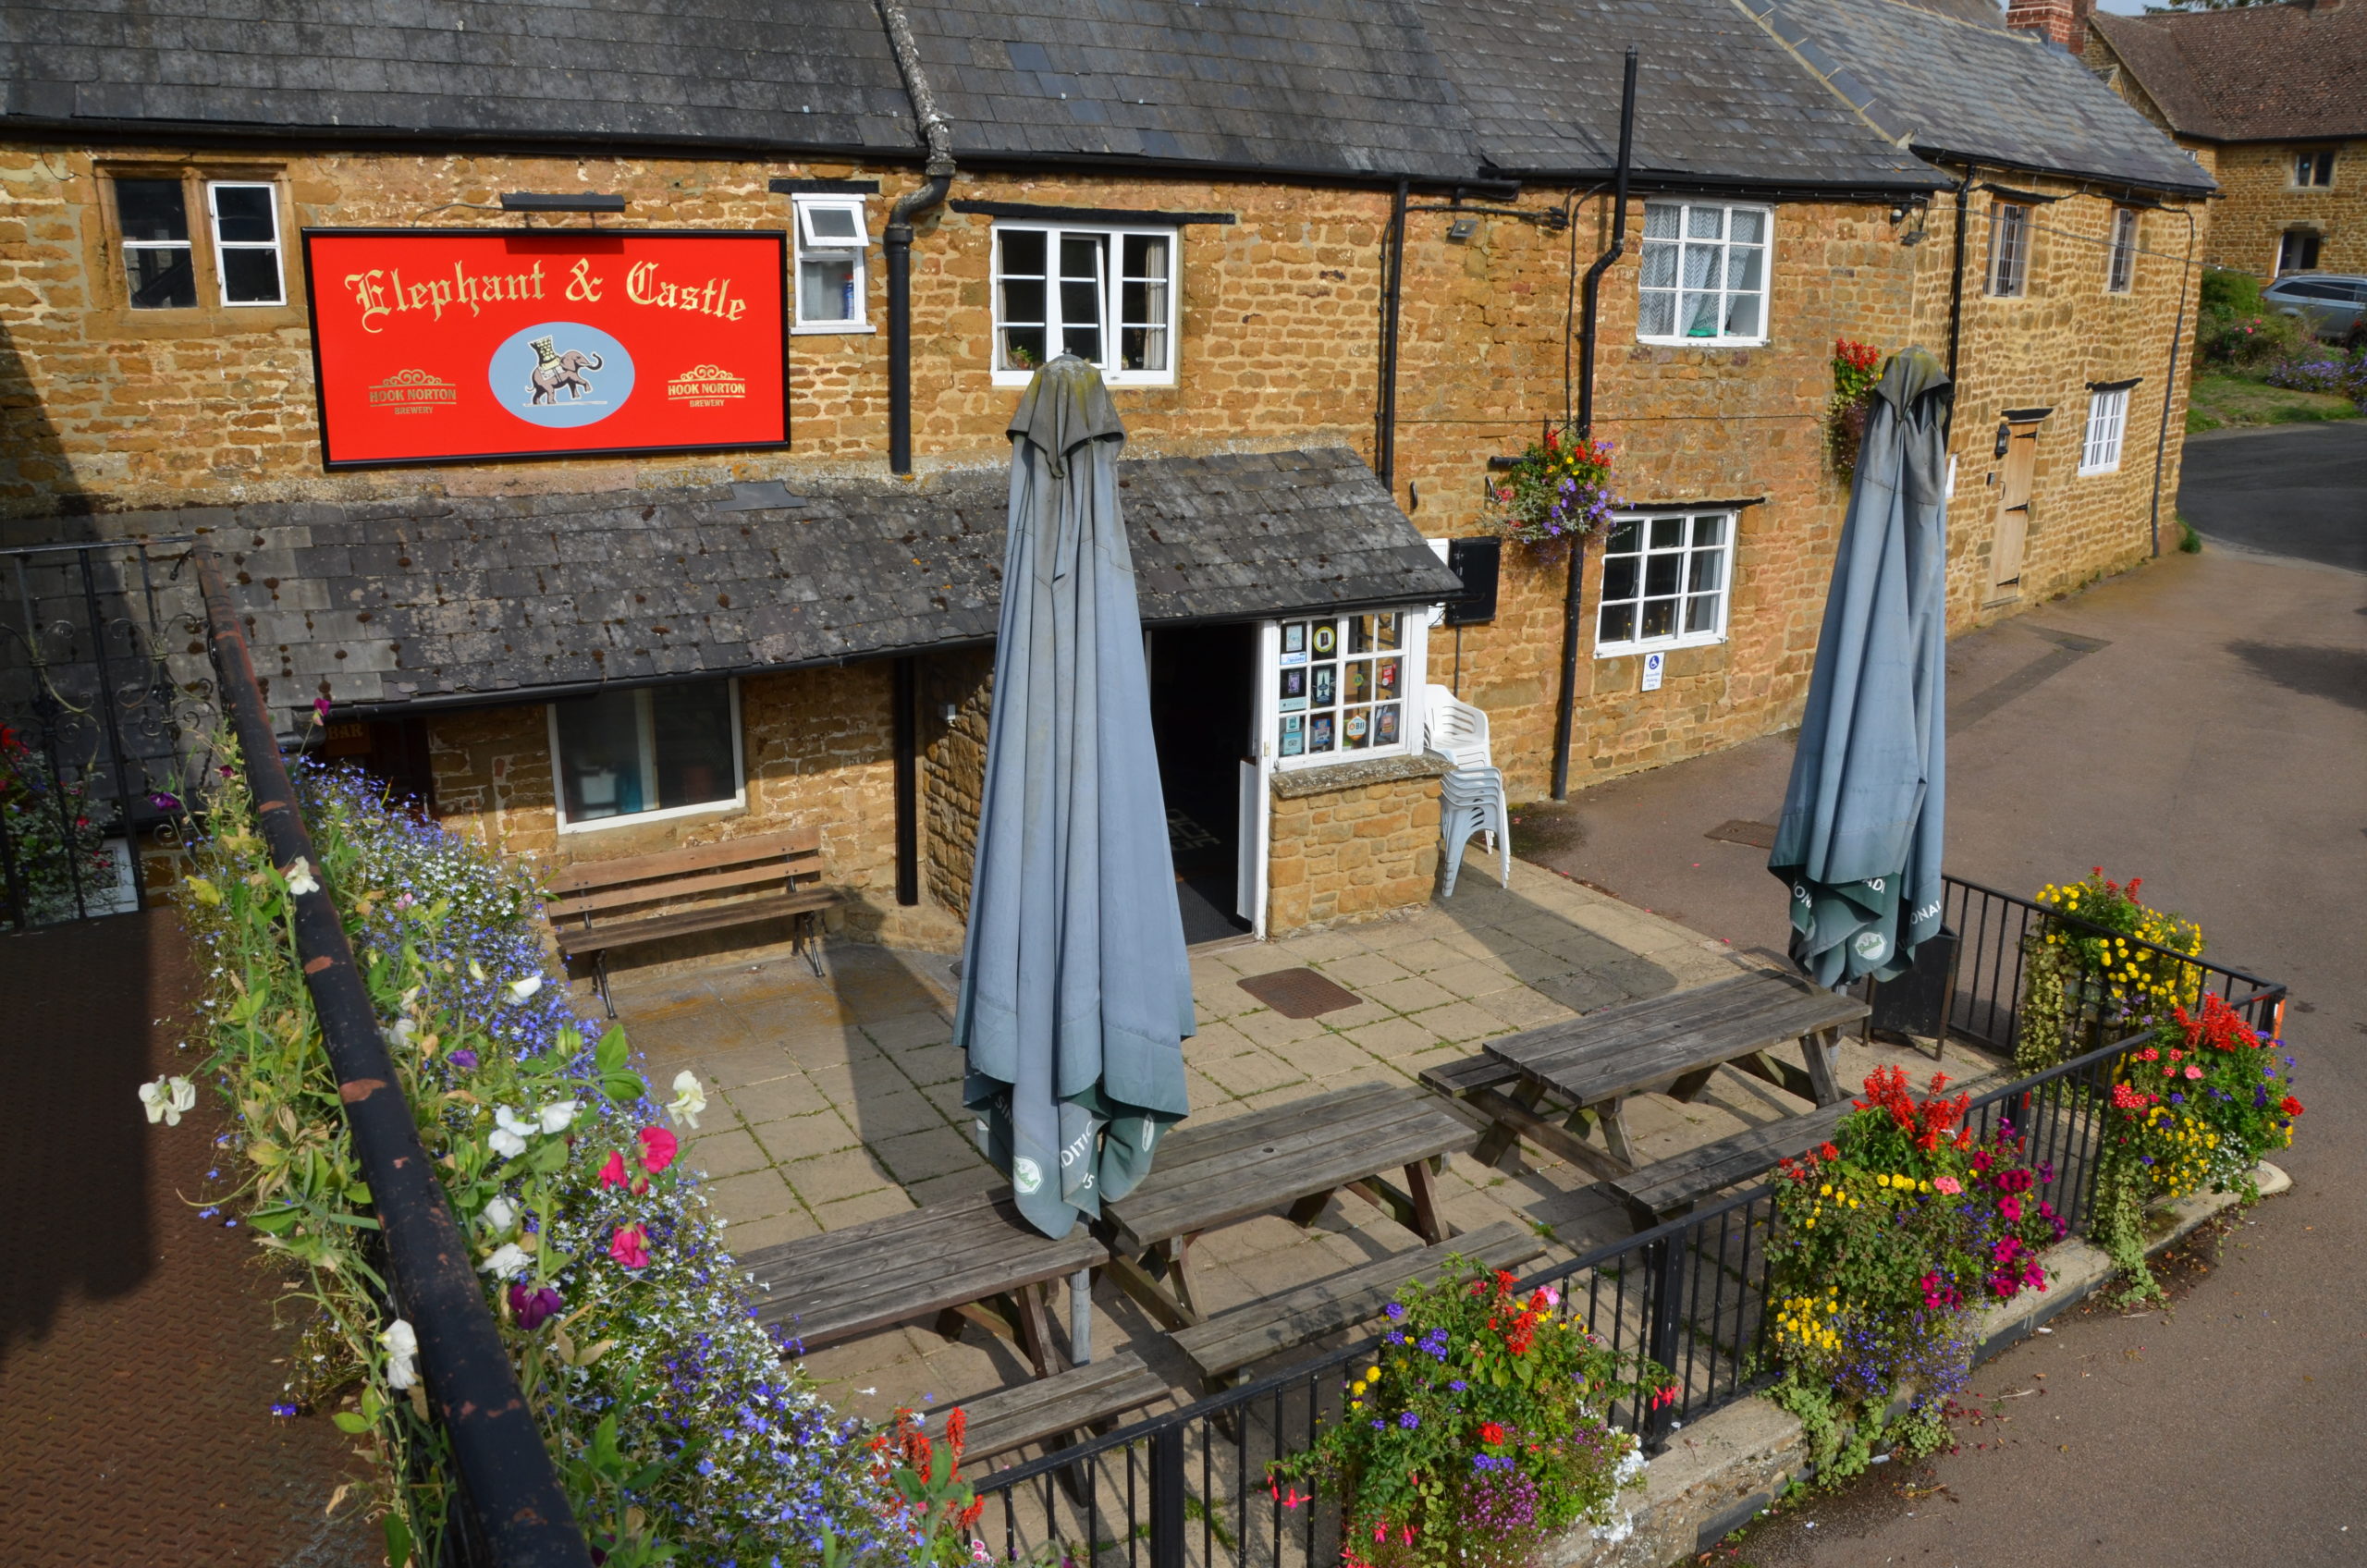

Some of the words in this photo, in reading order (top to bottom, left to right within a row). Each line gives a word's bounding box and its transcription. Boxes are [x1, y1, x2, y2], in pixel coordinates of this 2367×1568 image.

[344, 258, 546, 333] Elephant
[565, 257, 604, 302] &
[626, 261, 747, 322] Castle
[370, 390, 404, 402] HOOK
[407, 388, 456, 400] NORTON
[668, 384, 699, 396] HOOK
[702, 383, 745, 394] NORTON
[689, 398, 725, 408] BREWERY
[394, 407, 434, 415] BREWERY
[327, 724, 363, 741] BAR
